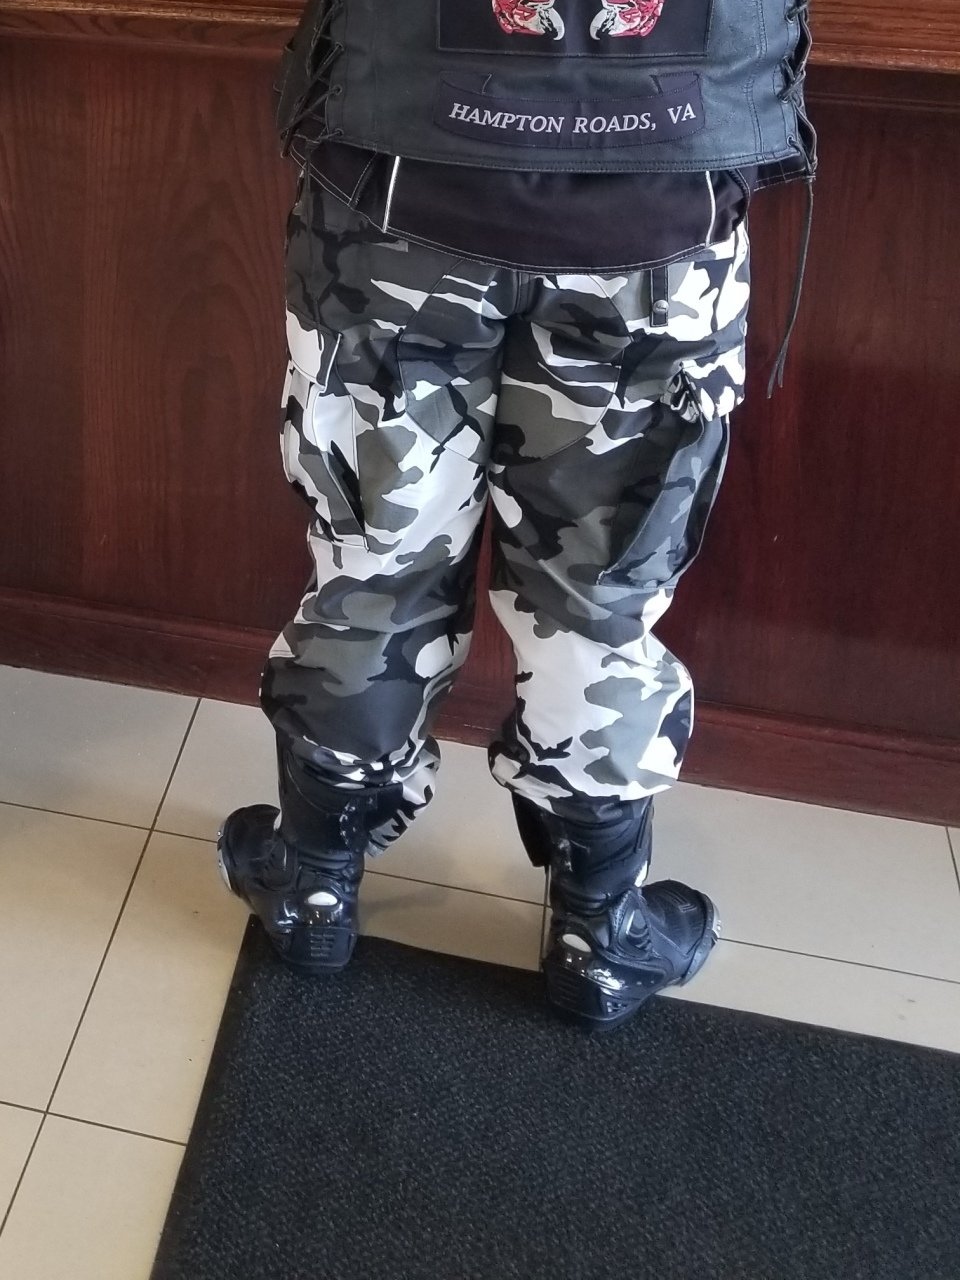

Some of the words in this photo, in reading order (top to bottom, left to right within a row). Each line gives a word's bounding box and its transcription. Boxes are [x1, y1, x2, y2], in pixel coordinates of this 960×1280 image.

[449, 103, 564, 134] HAMPTON
[573, 113, 656, 134] ROADS,
[668, 102, 696, 125] VA
